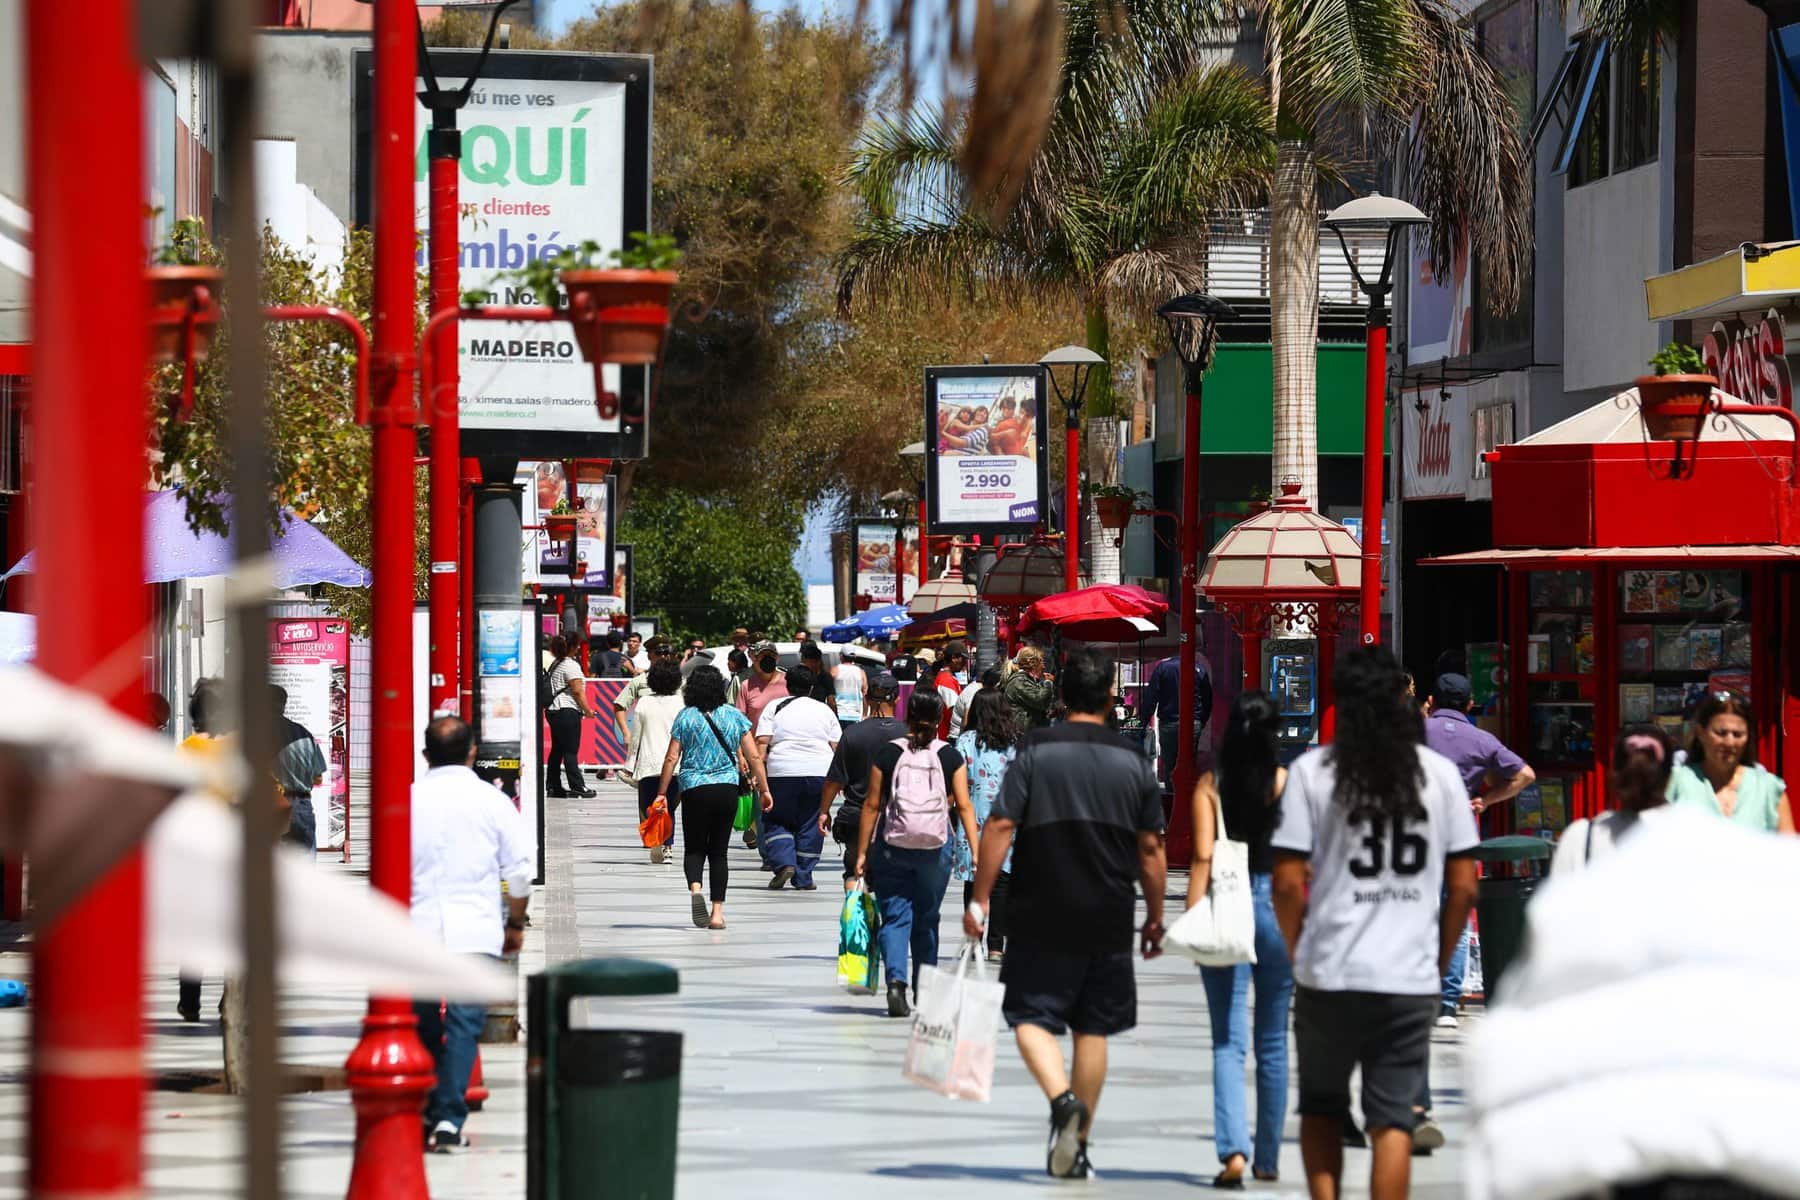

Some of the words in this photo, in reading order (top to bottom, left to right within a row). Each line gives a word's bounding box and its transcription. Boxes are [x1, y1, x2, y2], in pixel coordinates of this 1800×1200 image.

[492, 93, 521, 106] me
[526, 94, 555, 107] ves
[483, 197, 551, 217] clientes
[471, 339, 574, 358] MADERO
[1012, 506, 1036, 519] WOM
[1348, 804, 1428, 878] 36
